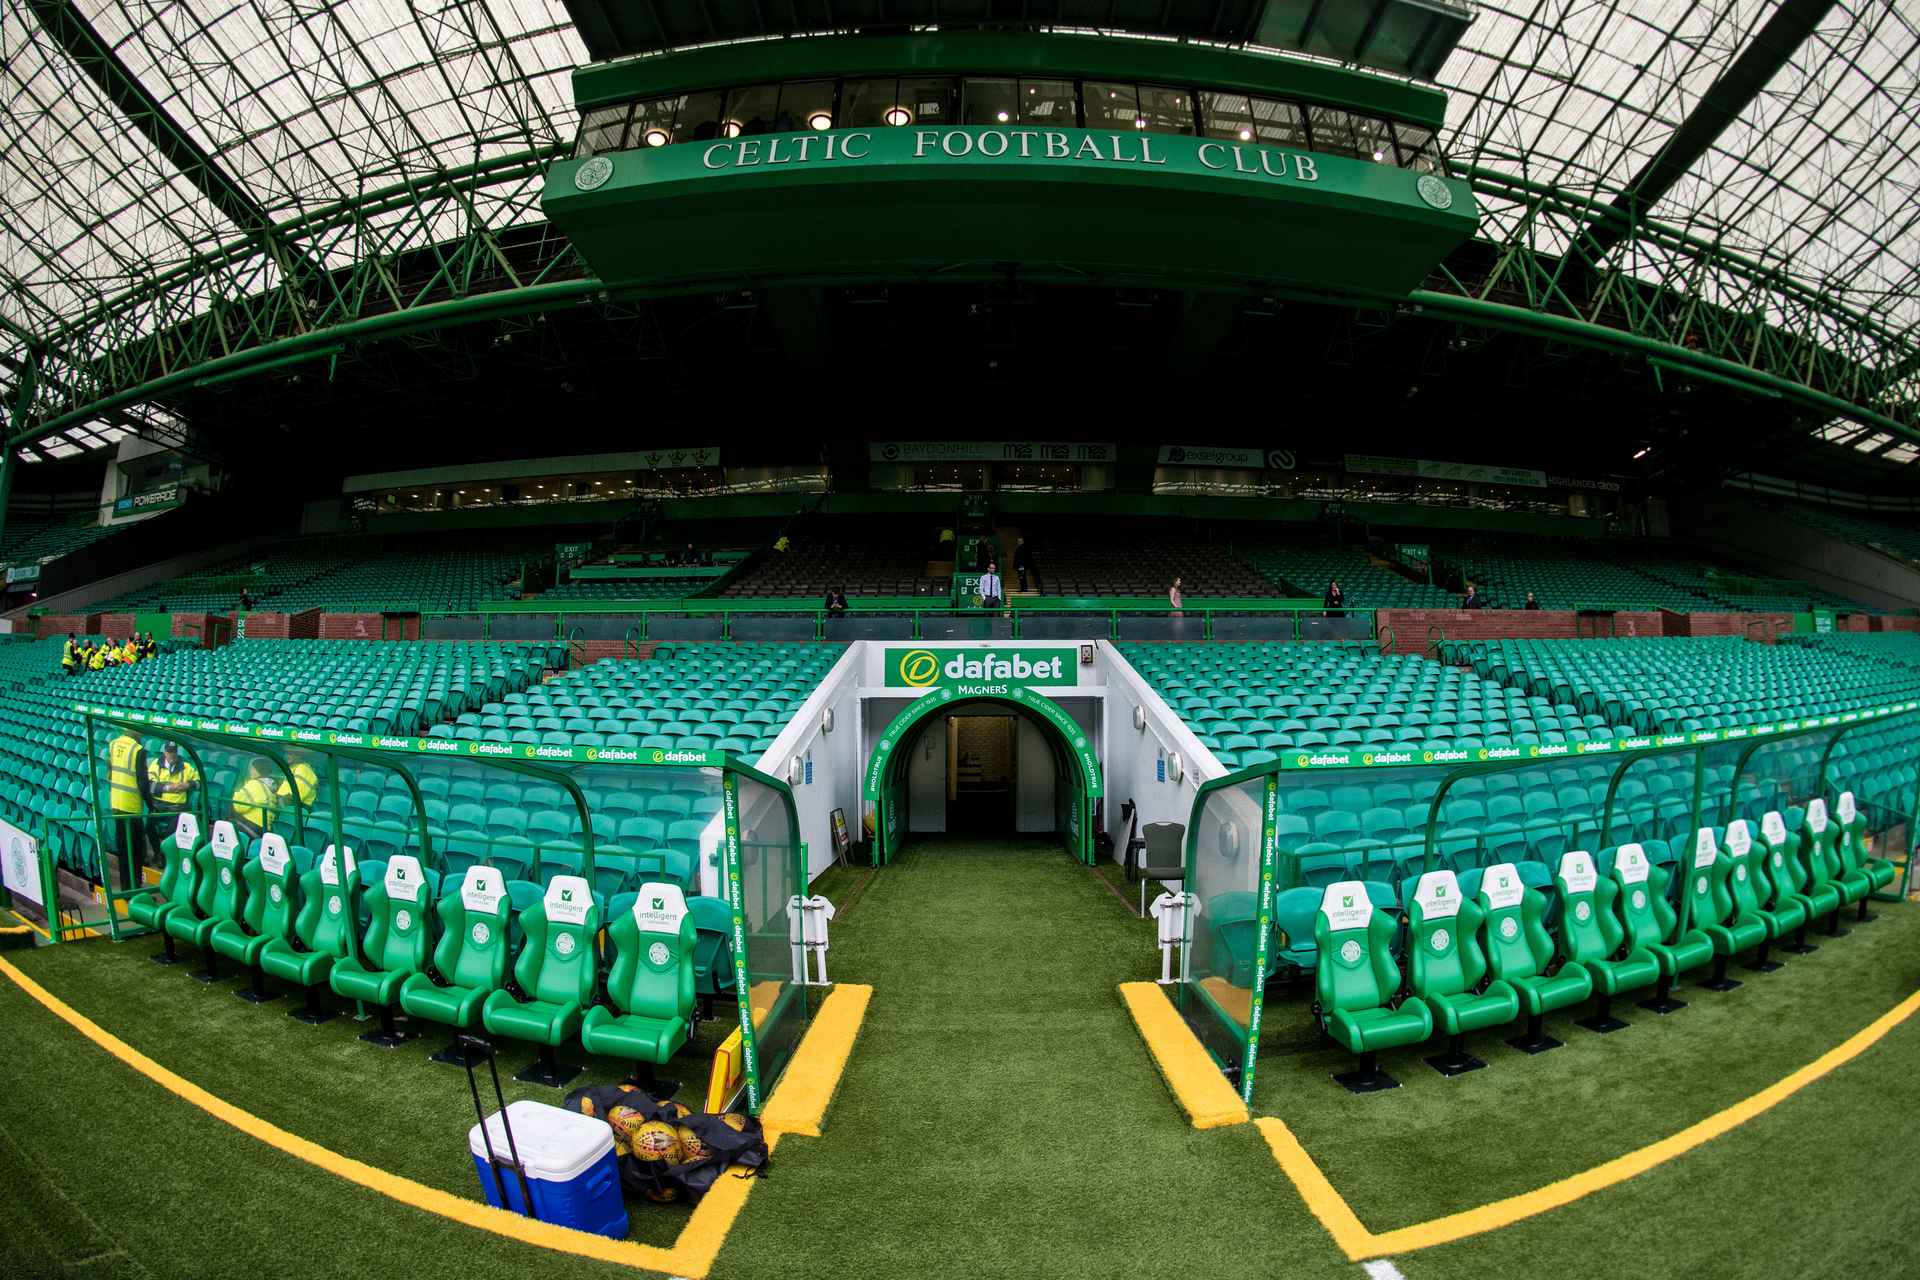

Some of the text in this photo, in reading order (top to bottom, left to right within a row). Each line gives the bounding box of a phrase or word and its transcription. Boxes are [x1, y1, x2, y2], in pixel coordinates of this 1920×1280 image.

[703, 130, 1320, 182] CELTIC FOOTBALL CLUB
[944, 653, 1062, 680] dafabet
[958, 684, 1008, 695] MAGNERS
[336, 733, 363, 744] dafabet
[380, 737, 408, 748] dafabet
[427, 740, 458, 751] dafabet
[478, 742, 513, 754] dafabet
[536, 746, 573, 758] dafabet
[598, 749, 638, 761] dafabet
[665, 751, 706, 763] dafabet
[1310, 755, 1349, 766] dafabet
[1374, 753, 1411, 764] dafabet
[1433, 750, 1468, 761] dafabet
[1488, 748, 1520, 758] dafabet
[1538, 745, 1568, 755] dafabet
[726, 790, 734, 820] dafabet
[550, 901, 583, 913] intelligent
[732, 881, 740, 909] dafabet
[1263, 880, 1271, 909] dafabet
[639, 911, 677, 921] intelligent
[735, 925, 743, 953] dafabet
